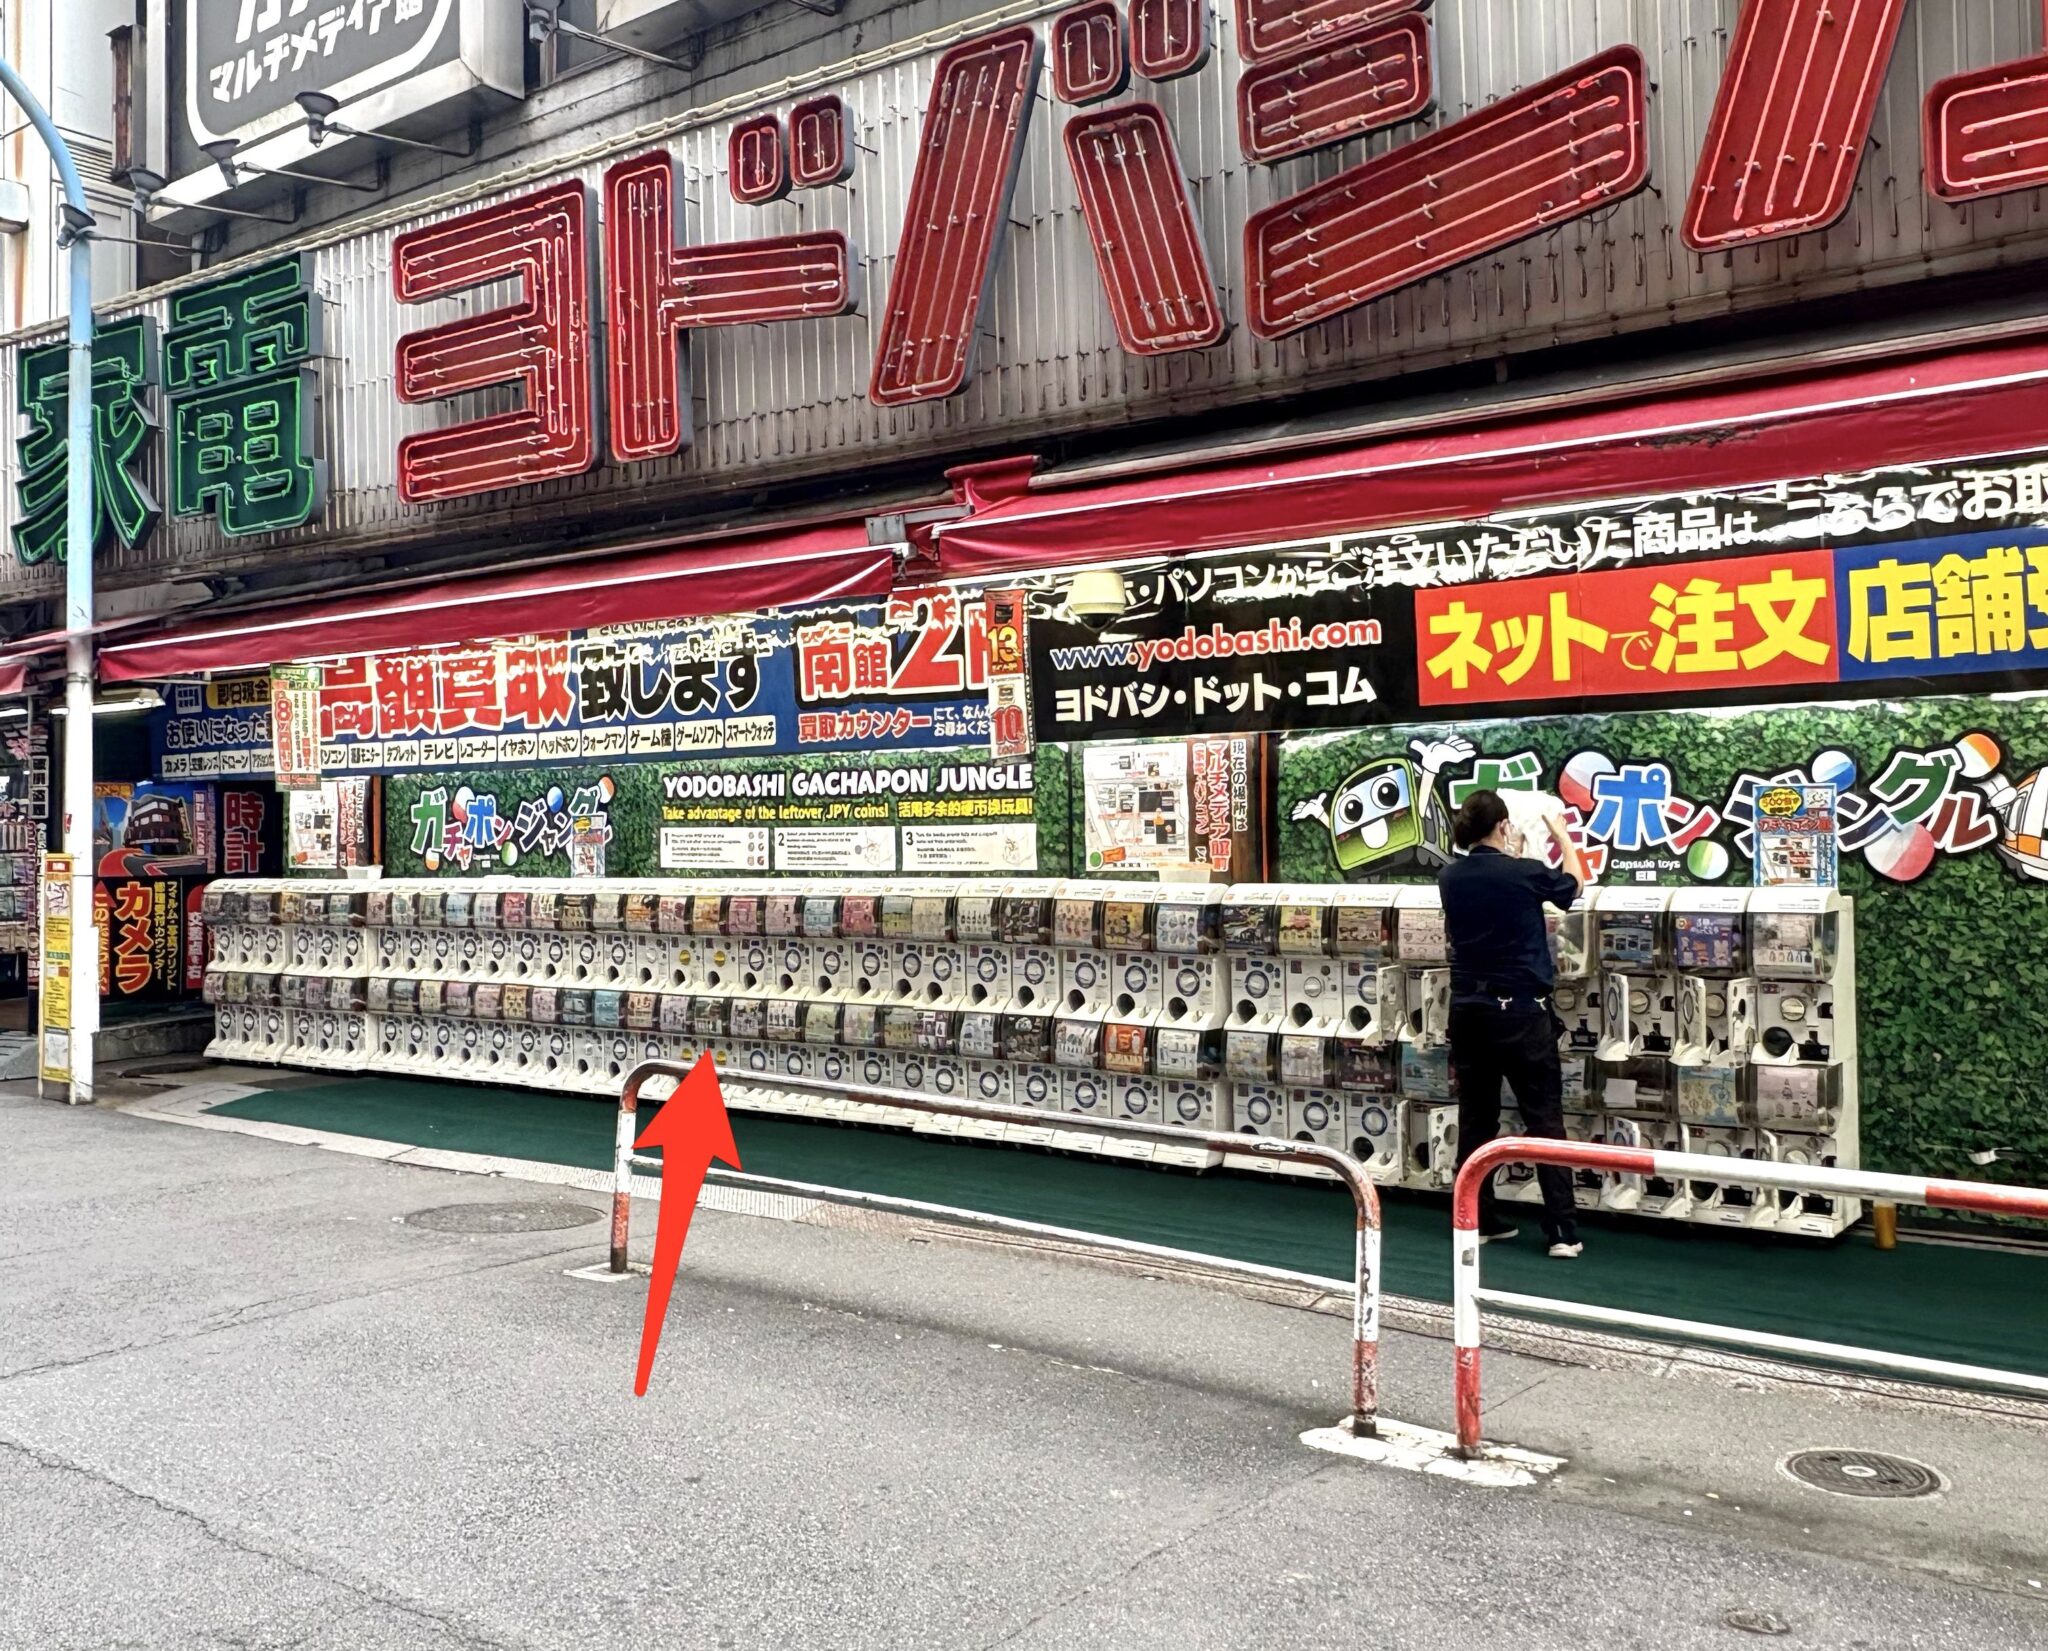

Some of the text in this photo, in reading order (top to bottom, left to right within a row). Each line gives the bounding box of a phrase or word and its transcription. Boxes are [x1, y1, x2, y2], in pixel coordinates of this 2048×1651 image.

[11, 252, 315, 567] 家電
[1426, 568, 1831, 690] ネットで注文
[1049, 616, 1382, 672] www.yodobashi.com
[1055, 666, 1377, 722] ヨドバシ・ドット・コム
[166, 711, 272, 749] お使いになった
[676, 724, 723, 745] ゲームソフト
[726, 720, 775, 742] スマートウォッチ
[798, 706, 933, 743] 買取カウンター
[540, 737, 580, 755] ヘッドホン
[582, 732, 626, 750] ウォークマン
[630, 727, 672, 749] ゲーム機
[386, 745, 417, 763] タブレット
[424, 744, 455, 761] テレビ
[459, 743, 496, 759] レコーダー
[500, 740, 536, 757] イヤホン
[164, 757, 188, 773] カメラ
[221, 754, 248, 770] ドローン
[663, 763, 1033, 799] YODOBASHI GACHAPON JUNGLE
[662, 802, 888, 822] Take advantage of the leftover JPY coins!
[224, 791, 265, 874] 時計
[664, 832, 669, 846] 1
[778, 832, 785, 846] 2
[905, 831, 914, 846] 3
[1611, 859, 1680, 870] Capsule toys
[113, 881, 154, 994] カメラ
